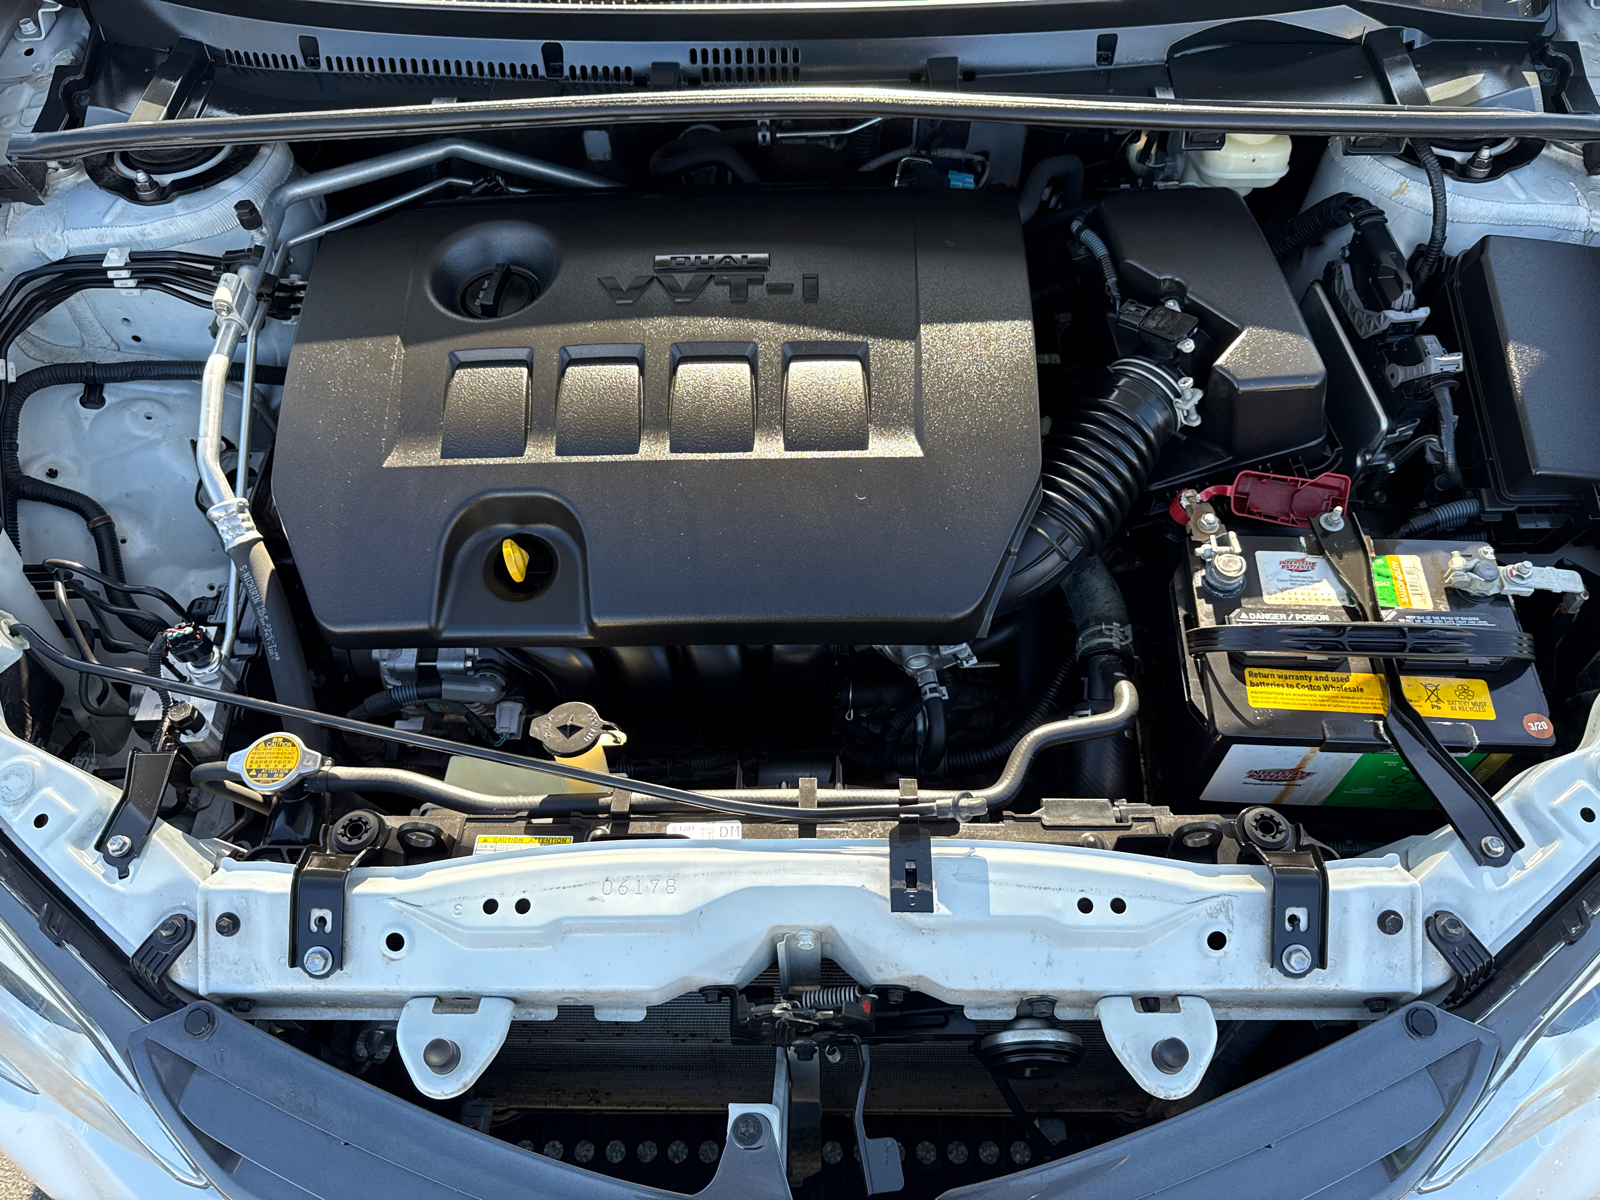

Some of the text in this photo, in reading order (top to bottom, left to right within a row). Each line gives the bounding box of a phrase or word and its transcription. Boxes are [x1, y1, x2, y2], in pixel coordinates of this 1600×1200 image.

[669, 254, 759, 266] DUAL
[1390, 560, 1409, 603] AUTOMOTIVE
[1248, 612, 1286, 620] DANGER
[1295, 613, 1330, 621] POISON
[1248, 670, 1350, 683] Return warranty and used
[1249, 680, 1285, 688] batteries
[1296, 683, 1322, 691] Costco
[1322, 684, 1364, 693] Wholesale
[1528, 720, 1548, 732] 3/20
[719, 825, 740, 838] DM
[602, 878, 676, 896] 06178
